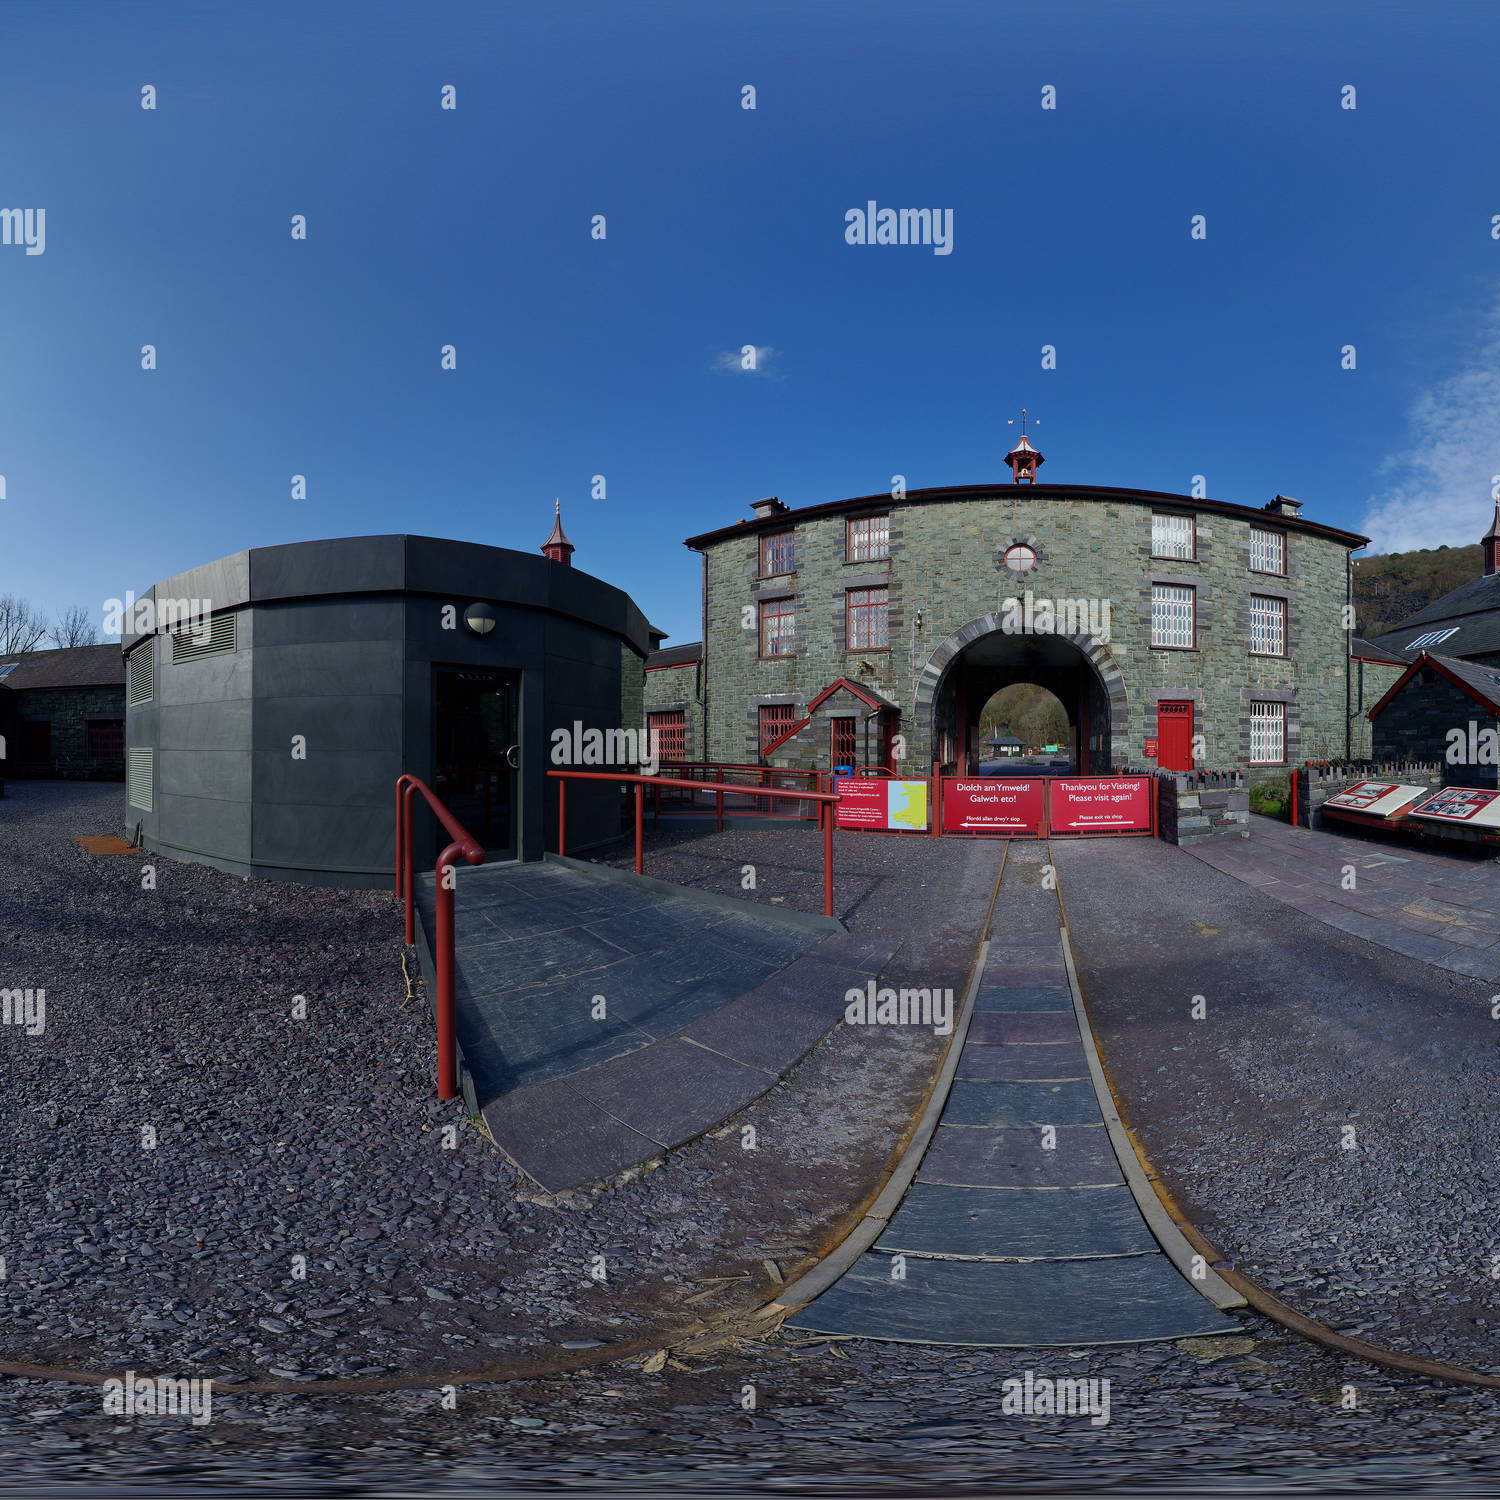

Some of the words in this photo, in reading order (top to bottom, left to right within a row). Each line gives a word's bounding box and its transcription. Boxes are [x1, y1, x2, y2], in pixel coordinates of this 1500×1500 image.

[956, 783, 982, 791] Diolch
[996, 783, 1030, 791] Ymweld!
[1060, 783, 1097, 792] Thankyou
[1111, 782, 1140, 791] Visiting!
[970, 795, 999, 803] Galwch
[1001, 795, 1017, 803] eto!
[1068, 794, 1092, 802] Please
[1111, 793, 1132, 803] again!
